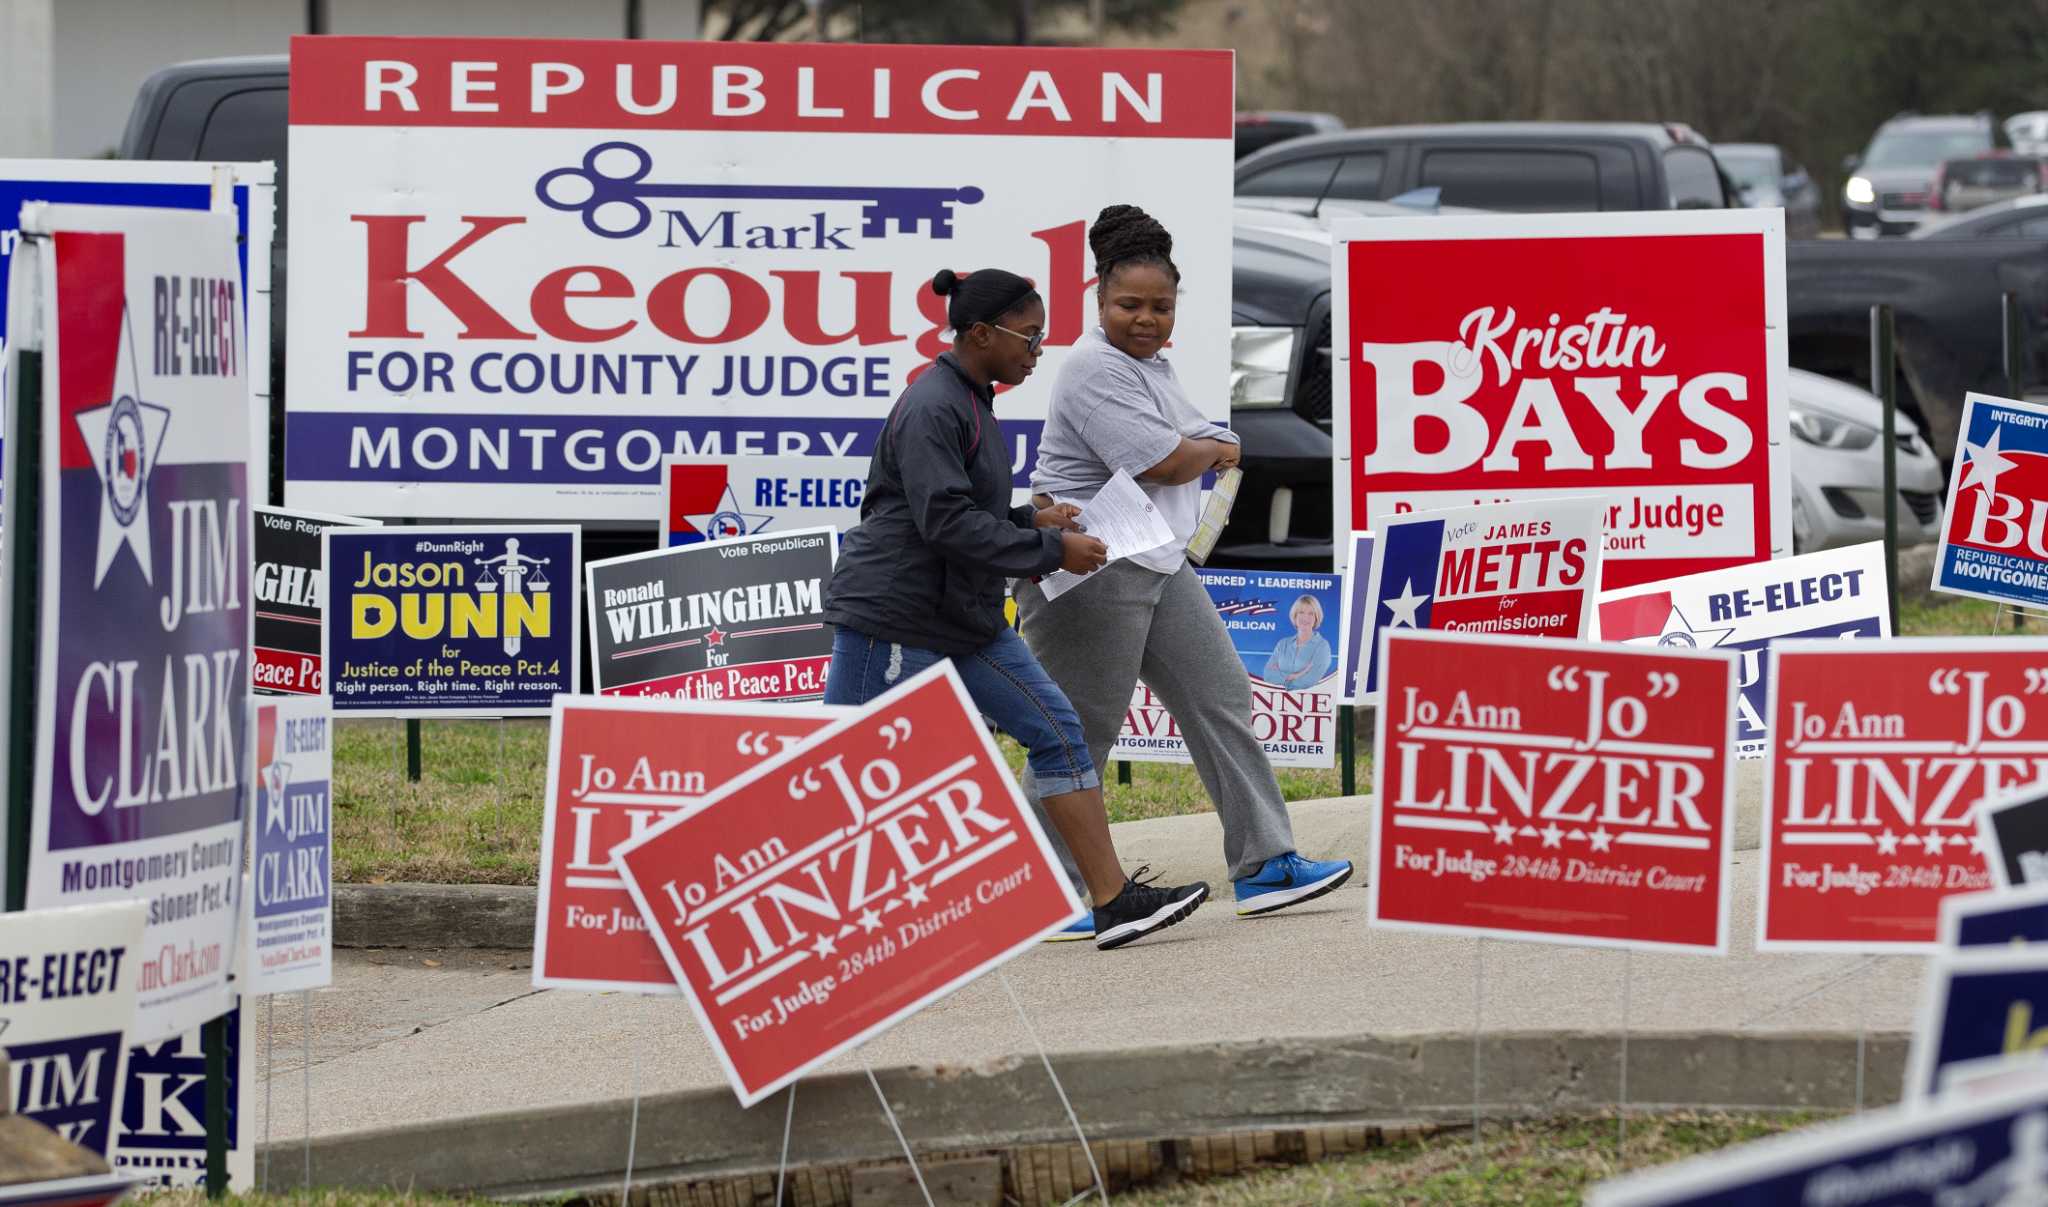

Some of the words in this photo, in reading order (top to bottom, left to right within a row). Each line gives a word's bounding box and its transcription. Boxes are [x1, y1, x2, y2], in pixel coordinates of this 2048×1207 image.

[364, 60, 1162, 123] REPUBLICAN
[658, 210, 855, 250] Mark
[154, 275, 237, 377] RE-ELECT
[1452, 306, 1666, 386] Kristin
[347, 351, 455, 393] FOR
[470, 352, 699, 395] COUNTY
[712, 355, 890, 397] JUDGE
[1363, 340, 1753, 475] BAYS
[1991, 409, 2048, 430] INTEGRITY
[755, 478, 867, 508] RE-ELEC
[263, 515, 292, 531] Vote
[295, 520, 322, 536] Rep
[1447, 521, 1478, 543] Vote
[1484, 521, 1551, 540] JAMES
[1629, 498, 1724, 536] Judge
[161, 499, 241, 632] JIM
[415, 540, 484, 555] #DunnRight
[719, 545, 748, 559] Vote
[752, 537, 824, 555] Republican
[1438, 538, 1587, 596] METTS
[1956, 548, 2033, 571] REPUBLICAN
[353, 551, 464, 588] Jason
[1258, 577, 1332, 590] LEADERSHIP
[1953, 561, 2048, 591] MONTGOME
[604, 580, 664, 608] Ronald
[606, 578, 823, 644] WILLINGHAM
[1498, 596, 1518, 611] for
[1708, 569, 1864, 622] RE-ELECT
[352, 592, 550, 640] DUNN
[1444, 613, 1568, 633] Commissioner
[341, 661, 399, 678] Justice
[404, 659, 423, 677] of
[428, 659, 454, 676] the
[460, 660, 511, 677] Peace
[441, 644, 461, 658] for
[706, 649, 729, 668] For
[336, 681, 366, 693] Right
[370, 684, 413, 694] person.
[418, 681, 448, 693] Right
[452, 681, 480, 692] time.
[485, 680, 514, 693] Right
[519, 682, 562, 691] reason.
[696, 678, 723, 699] the
[728, 669, 780, 697] Peace
[1397, 686, 1438, 732] Jo
[1445, 690, 1521, 731] Ann
[1785, 702, 1826, 749] Jo
[1831, 701, 1905, 738] Ann
[69, 649, 240, 816] CLARK
[571, 754, 616, 797] Jo
[624, 756, 706, 793] Ann
[1393, 741, 1712, 831] LINZER
[287, 793, 325, 843] JIM
[62, 849, 189, 893] Montgomery
[191, 838, 234, 872] County
[259, 846, 324, 906] CLARK
[662, 880, 706, 926] Jo
[712, 836, 789, 893] Ann
[683, 778, 1010, 992] LINZER
[1395, 844, 1433, 871] For
[1432, 847, 1497, 882] Judge
[1500, 854, 1560, 881] 284th
[1564, 857, 1641, 887] District
[1646, 864, 1706, 893] Court
[1782, 862, 1820, 887] For
[1820, 862, 1881, 895] Judge
[566, 905, 607, 928] For
[137, 939, 220, 992] mClark.com
[731, 1010, 774, 1041] For
[771, 973, 836, 1026] Judge
[838, 938, 896, 983] 284th
[899, 895, 973, 950] District
[977, 862, 1032, 905] Court
